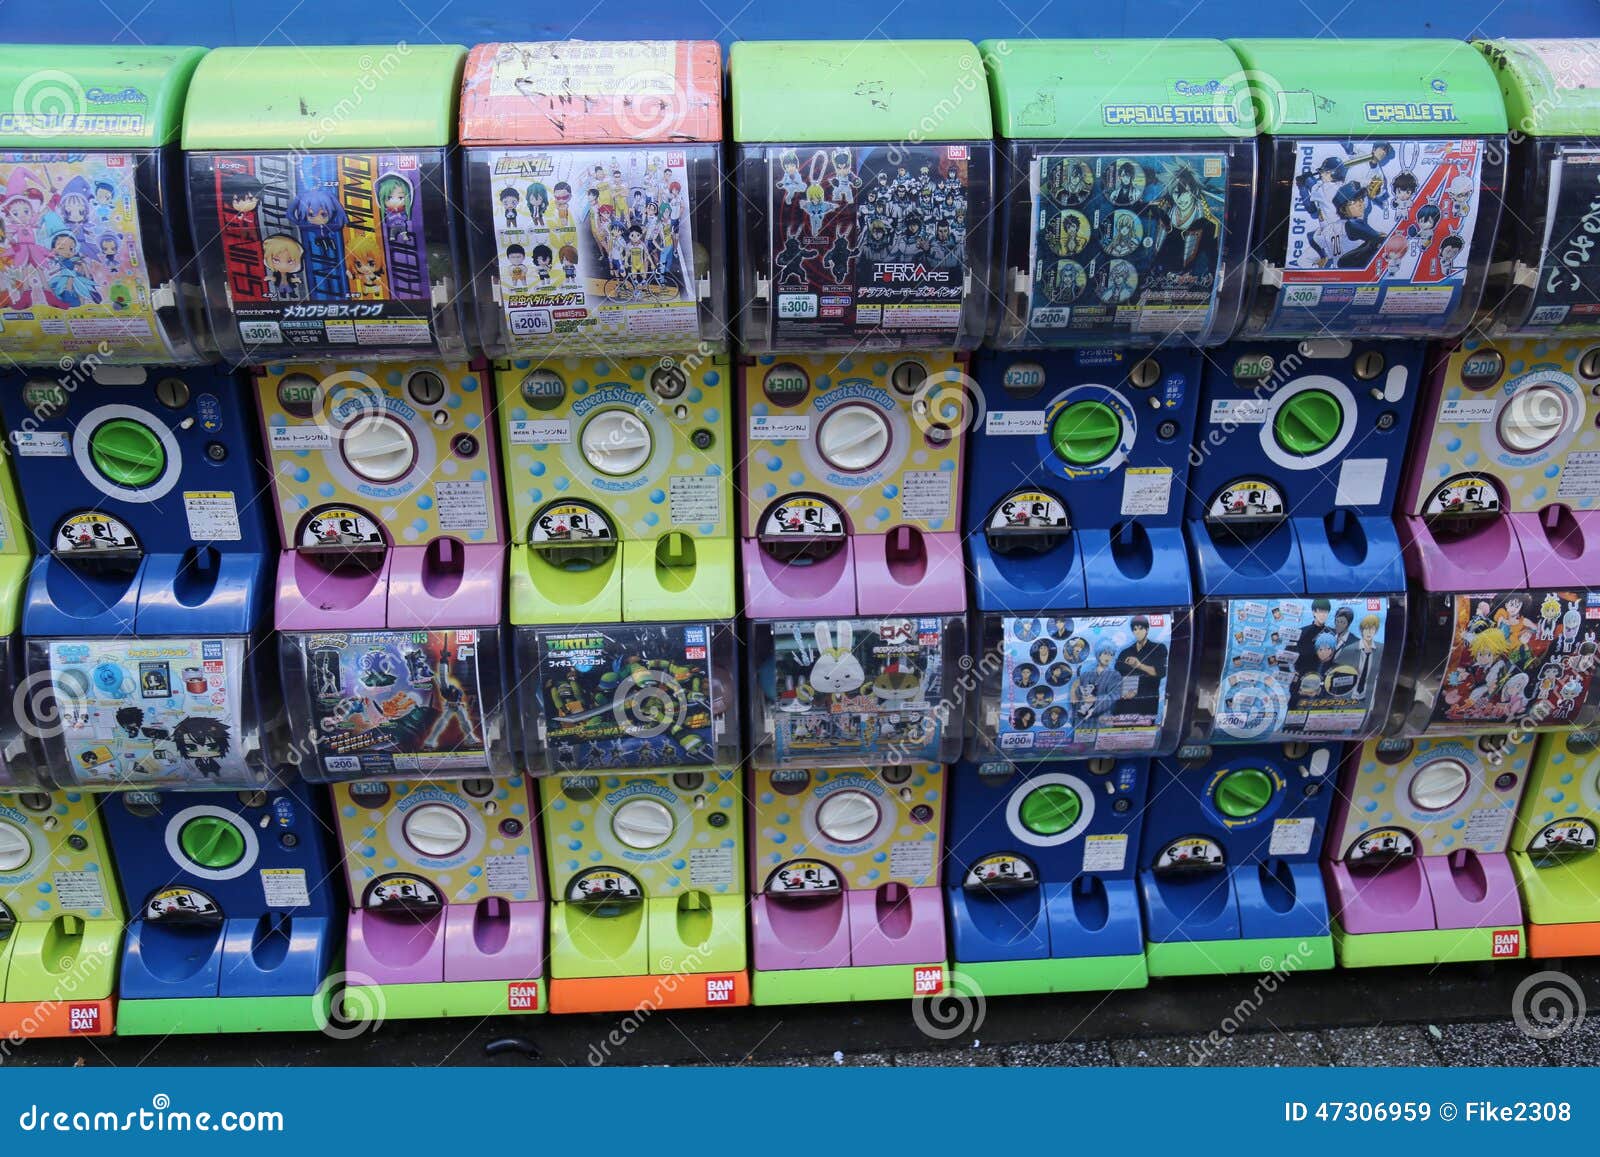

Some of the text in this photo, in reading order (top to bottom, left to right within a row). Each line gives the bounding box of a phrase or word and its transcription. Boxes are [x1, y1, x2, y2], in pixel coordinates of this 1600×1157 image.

[1105, 105, 1237, 124] CAPSULE STATION
[1365, 103, 1432, 122] CAPSULE
[1292, 217, 1306, 235] Of
[1289, 240, 1304, 267] Ace
[874, 263, 927, 273] TERRA
[284, 303, 384, 318] メカクシ団スイング
[1463, 361, 1497, 375] ¥200
[768, 377, 804, 391] ¥300
[1006, 371, 1040, 385] ¥200
[527, 382, 562, 395] ¥200
[572, 386, 657, 418] SweetsStation
[814, 382, 897, 413] SweetsStation
[1007, 419, 1042, 427] トーシンNJ
[545, 637, 605, 650] TURTLES
[605, 783, 678, 806] SweetsStation
[1494, 934, 1518, 945] BAN
[1495, 945, 1513, 954] DAI
[915, 971, 941, 981] BAN
[510, 986, 536, 997] BAN
[707, 980, 733, 990] BAN
[916, 981, 936, 991] DAI
[510, 997, 531, 1008] DAI
[708, 991, 729, 1001] DAI
[71, 1008, 98, 1019] BAN
[71, 1019, 93, 1030] DAI
